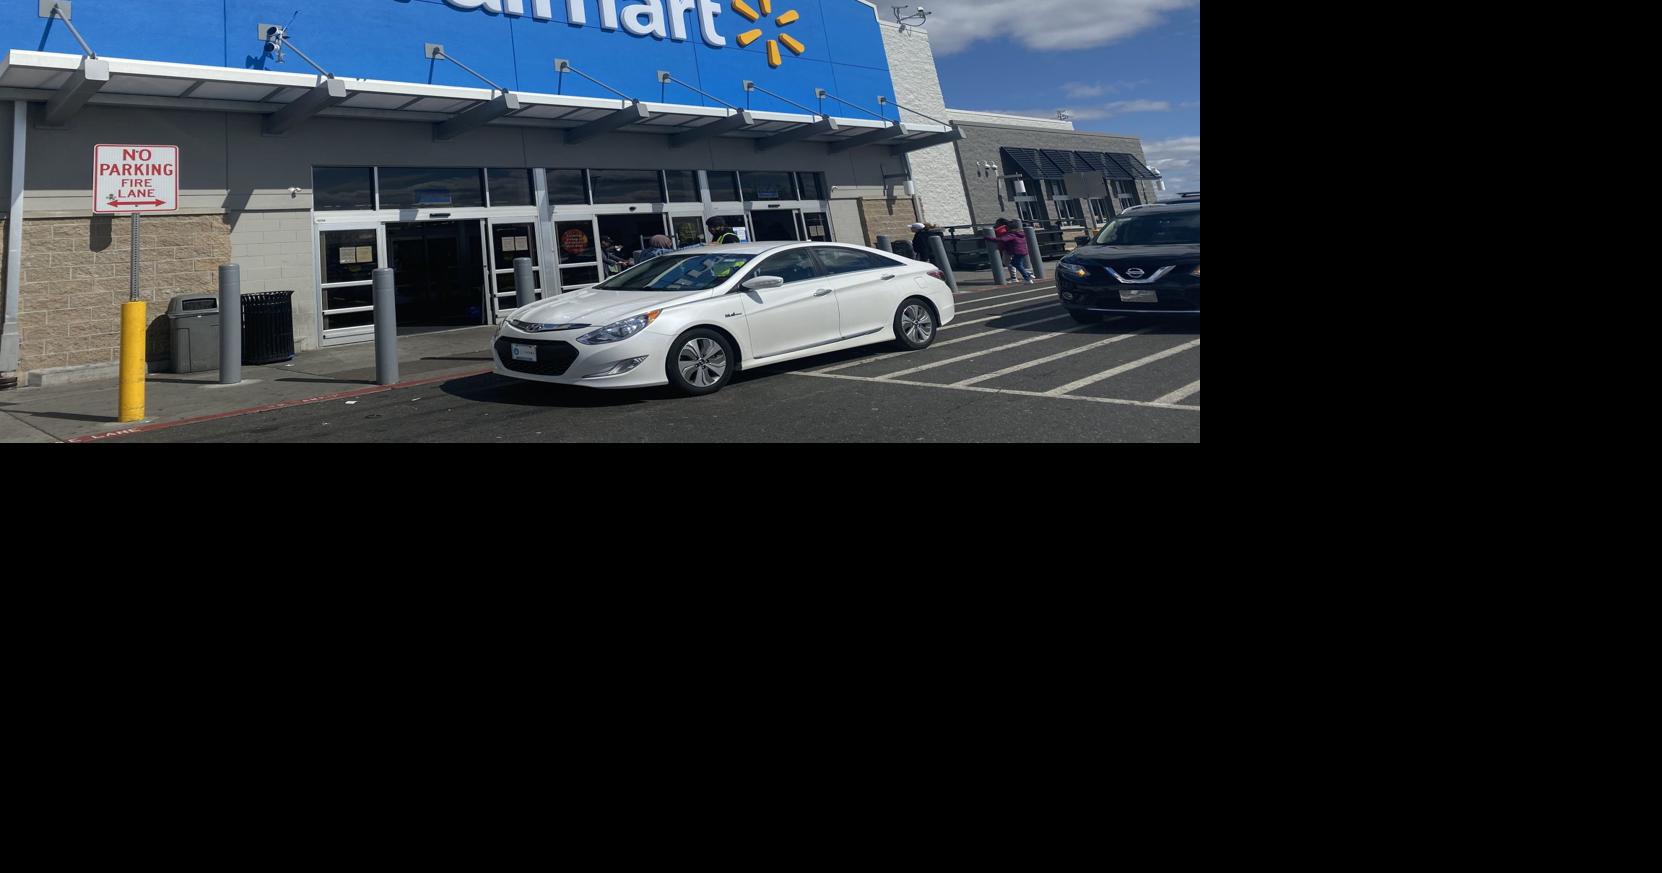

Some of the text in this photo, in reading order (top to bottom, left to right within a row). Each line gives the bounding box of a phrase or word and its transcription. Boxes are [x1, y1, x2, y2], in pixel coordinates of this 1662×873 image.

[441, 0, 727, 47] mart
[122, 149, 152, 161] NO
[100, 163, 173, 176] PARKING
[121, 178, 153, 188] FIRE
[118, 189, 156, 198] LANE
